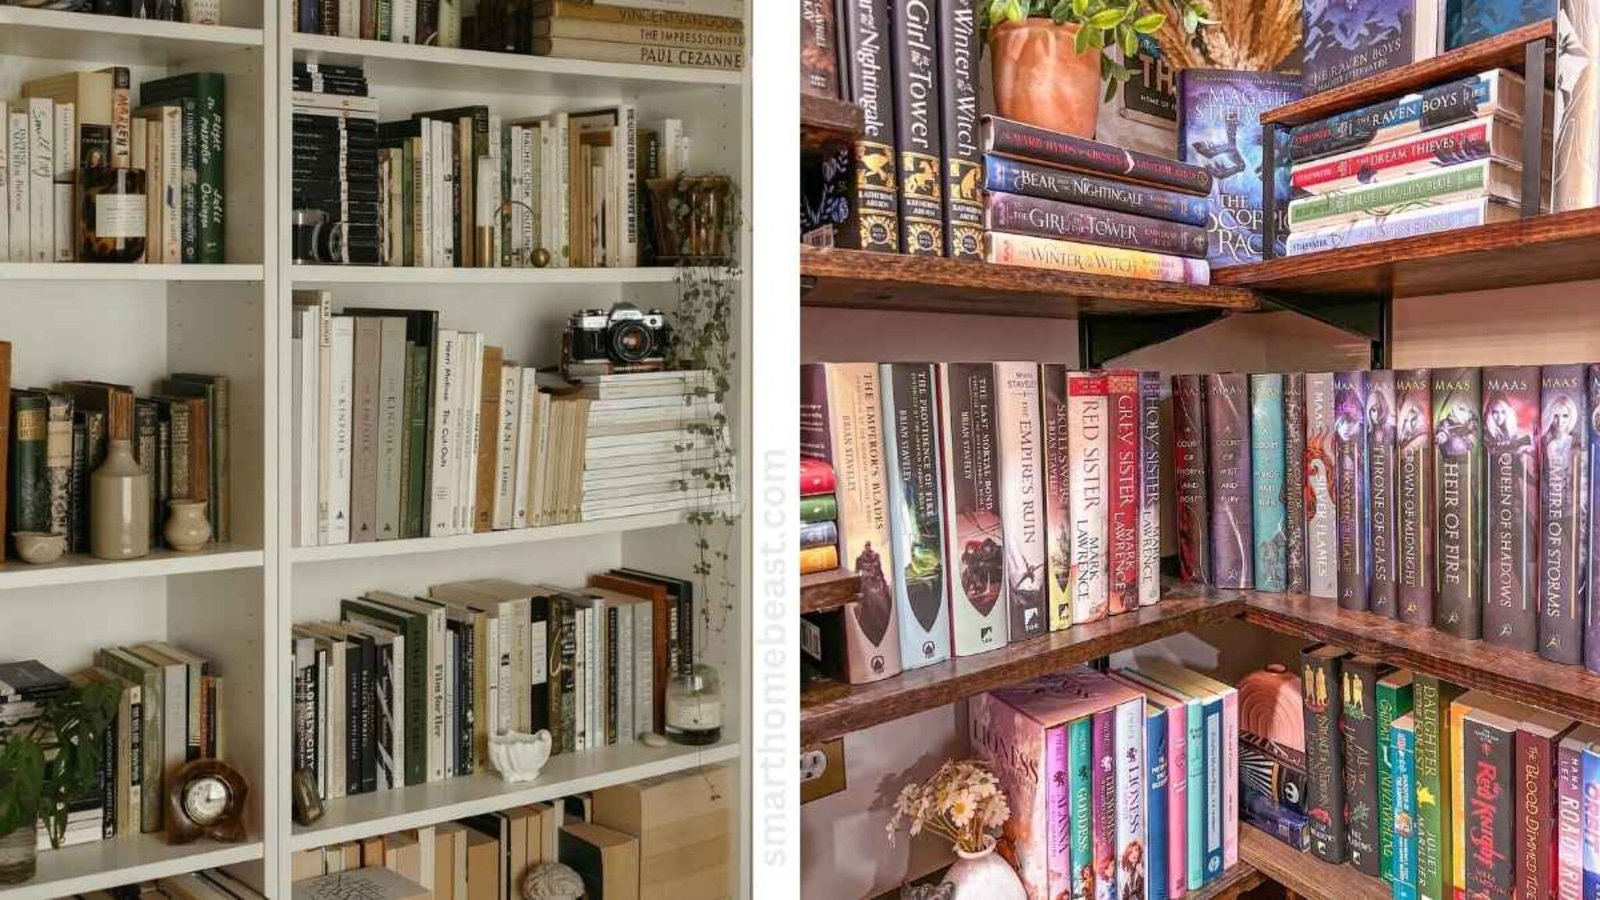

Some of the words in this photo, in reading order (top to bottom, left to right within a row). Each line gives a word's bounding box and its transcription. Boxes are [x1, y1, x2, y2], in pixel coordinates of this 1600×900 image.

[640, 29, 658, 41] THE
[661, 30, 744, 46] IMPRESSIONISTS
[906, 0, 932, 51] Girl
[952, 3, 974, 75] Winter
[640, 47, 673, 64] PAUL
[679, 50, 742, 68] CEZANNE
[1331, 53, 1369, 78] RAVEN
[1373, 37, 1402, 61] BOYS
[857, 31, 885, 137] Nightingale
[1208, 86, 1291, 106] MAGGIE
[908, 70, 933, 150] Tower
[956, 98, 977, 157] Witch
[1371, 104, 1418, 127] RAVEN
[1422, 92, 1458, 114] BOYS
[1370, 149, 1408, 167] DREAM
[1411, 137, 1456, 157] THIEVES
[1017, 169, 1059, 192] BEAR
[1073, 178, 1143, 206] NIGHTINGALE
[1220, 194, 1250, 209] THE
[1028, 207, 1070, 235] GIRL
[1088, 215, 1138, 245] TOWER
[1029, 247, 1082, 270] WINTER
[1094, 255, 1138, 273] WITCH
[863, 373, 876, 401] THE
[918, 373, 928, 395] THE
[978, 377, 987, 400] THE
[1397, 380, 1427, 391] MAAS
[1435, 380, 1472, 391] MAAS
[1487, 380, 1528, 391] MAAS
[1543, 378, 1578, 389] MAAS
[842, 415, 852, 446] BRIAN
[899, 409, 909, 441] BRIAN
[919, 398, 932, 471] PROVIDENCE
[961, 411, 971, 441] BRIAN
[980, 404, 990, 430] LAST
[1081, 399, 1100, 441] RED
[1117, 395, 1134, 446] GREY
[1143, 397, 1161, 447] HOLY
[865, 404, 880, 477] EMPEROR'S
[982, 432, 992, 477] MORTAL
[924, 474, 934, 489] OF
[1083, 447, 1102, 511] SISTER
[1118, 450, 1136, 509] SISTER
[1144, 451, 1161, 507] SISTER
[1220, 481, 1239, 490] AND
[1373, 446, 1387, 512] THRONE
[1403, 446, 1416, 496] CROWN
[1444, 462, 1460, 509] HEIR
[1498, 453, 1513, 504] QUEEN
[1549, 455, 1562, 518] EMPIRE
[872, 482, 885, 531] BLADES
[925, 491, 936, 518] FIRE
[983, 479, 994, 511] BOND
[1404, 499, 1416, 520] OF
[1023, 501, 1036, 545] RUIN
[1374, 514, 1386, 532] OF
[1445, 512, 1461, 540] OF
[1500, 508, 1513, 529] OF
[1548, 522, 1562, 546] OF
[1076, 518, 1090, 600] LAWRENCE
[1088, 536, 1101, 580] MARK
[1112, 511, 1127, 593] LAWRENCE
[1121, 527, 1136, 576] MARK
[1142, 508, 1155, 585] LAWRENCE
[1373, 534, 1387, 581] GLASS
[1404, 522, 1417, 587] MIDNIGHT
[1445, 543, 1461, 585] FIRE
[1499, 531, 1513, 609] SHADOWS
[1547, 547, 1562, 618] STORMS
[433, 664, 443, 693] Film
[305, 682, 315, 737] LONELY
[1422, 684, 1438, 777] DAUGHTER
[305, 739, 315, 770] CITY
[973, 719, 1039, 785] LIONESS
[1415, 720, 1425, 771] FOREST
[1526, 746, 1539, 763] THE
[1525, 765, 1540, 815] BLOOD
[1560, 760, 1569, 782] LEE
[1571, 756, 1580, 790] HANA
[1077, 786, 1090, 853] GODDESS
[1128, 764, 1141, 834] LIONESS
[1379, 770, 1394, 857] NEVERWHERE
[1560, 795, 1581, 847] ROAD
[1417, 814, 1428, 886] MARILLIER
[1426, 832, 1437, 876] JULIET
[1525, 815, 1540, 873] DIMMED
[1525, 875, 1539, 900] TIDE
